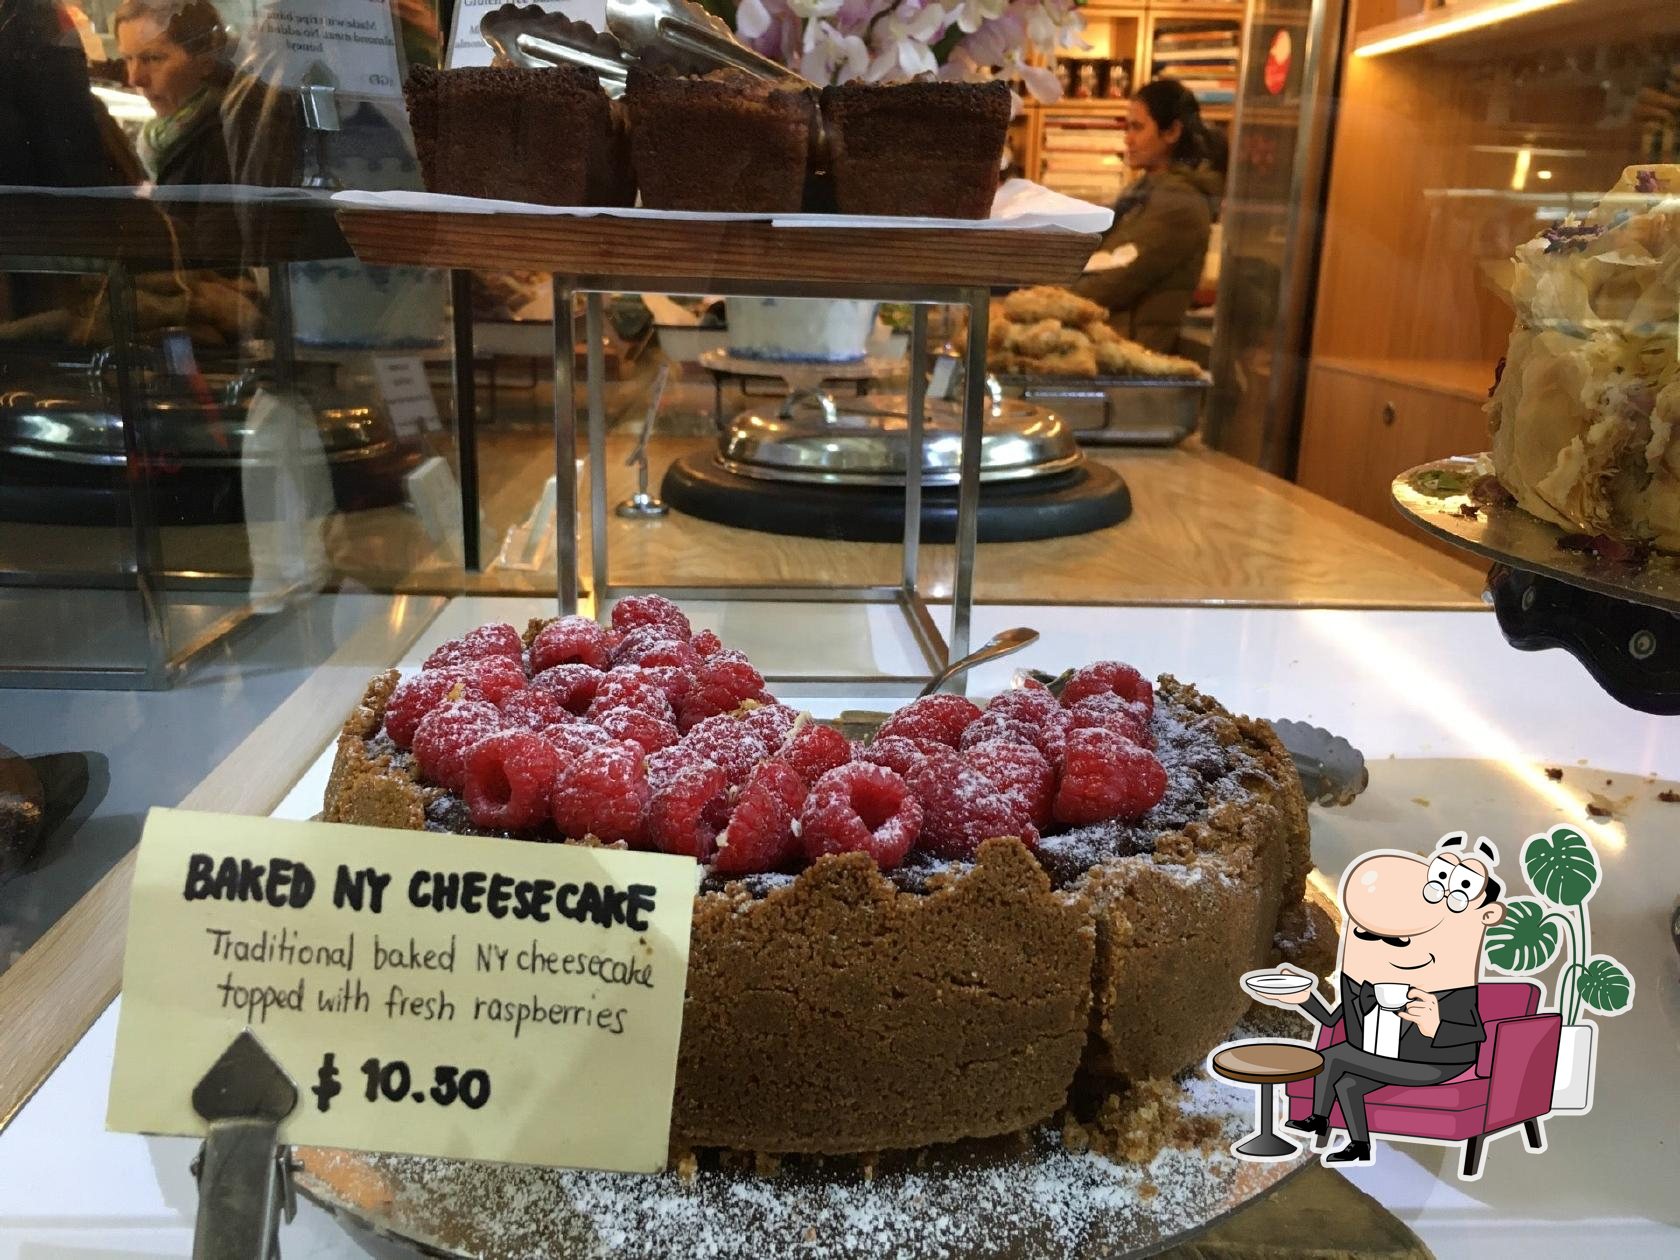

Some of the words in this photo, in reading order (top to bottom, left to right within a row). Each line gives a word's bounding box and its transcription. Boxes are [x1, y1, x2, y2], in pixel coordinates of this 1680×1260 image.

[182, 853, 316, 909] BAKED
[333, 864, 392, 914] NY
[408, 870, 657, 932] CHEESECAKE
[206, 926, 354, 971] Traditional
[373, 933, 457, 973] baked
[476, 942, 509, 973] NY
[516, 938, 654, 988] cheesecake
[216, 971, 305, 1024] topped
[317, 977, 370, 1013] with
[384, 984, 456, 1021] fresh
[473, 992, 628, 1039] raspberries
[311, 1052, 342, 1113] $
[360, 1058, 491, 1110] 10.50
